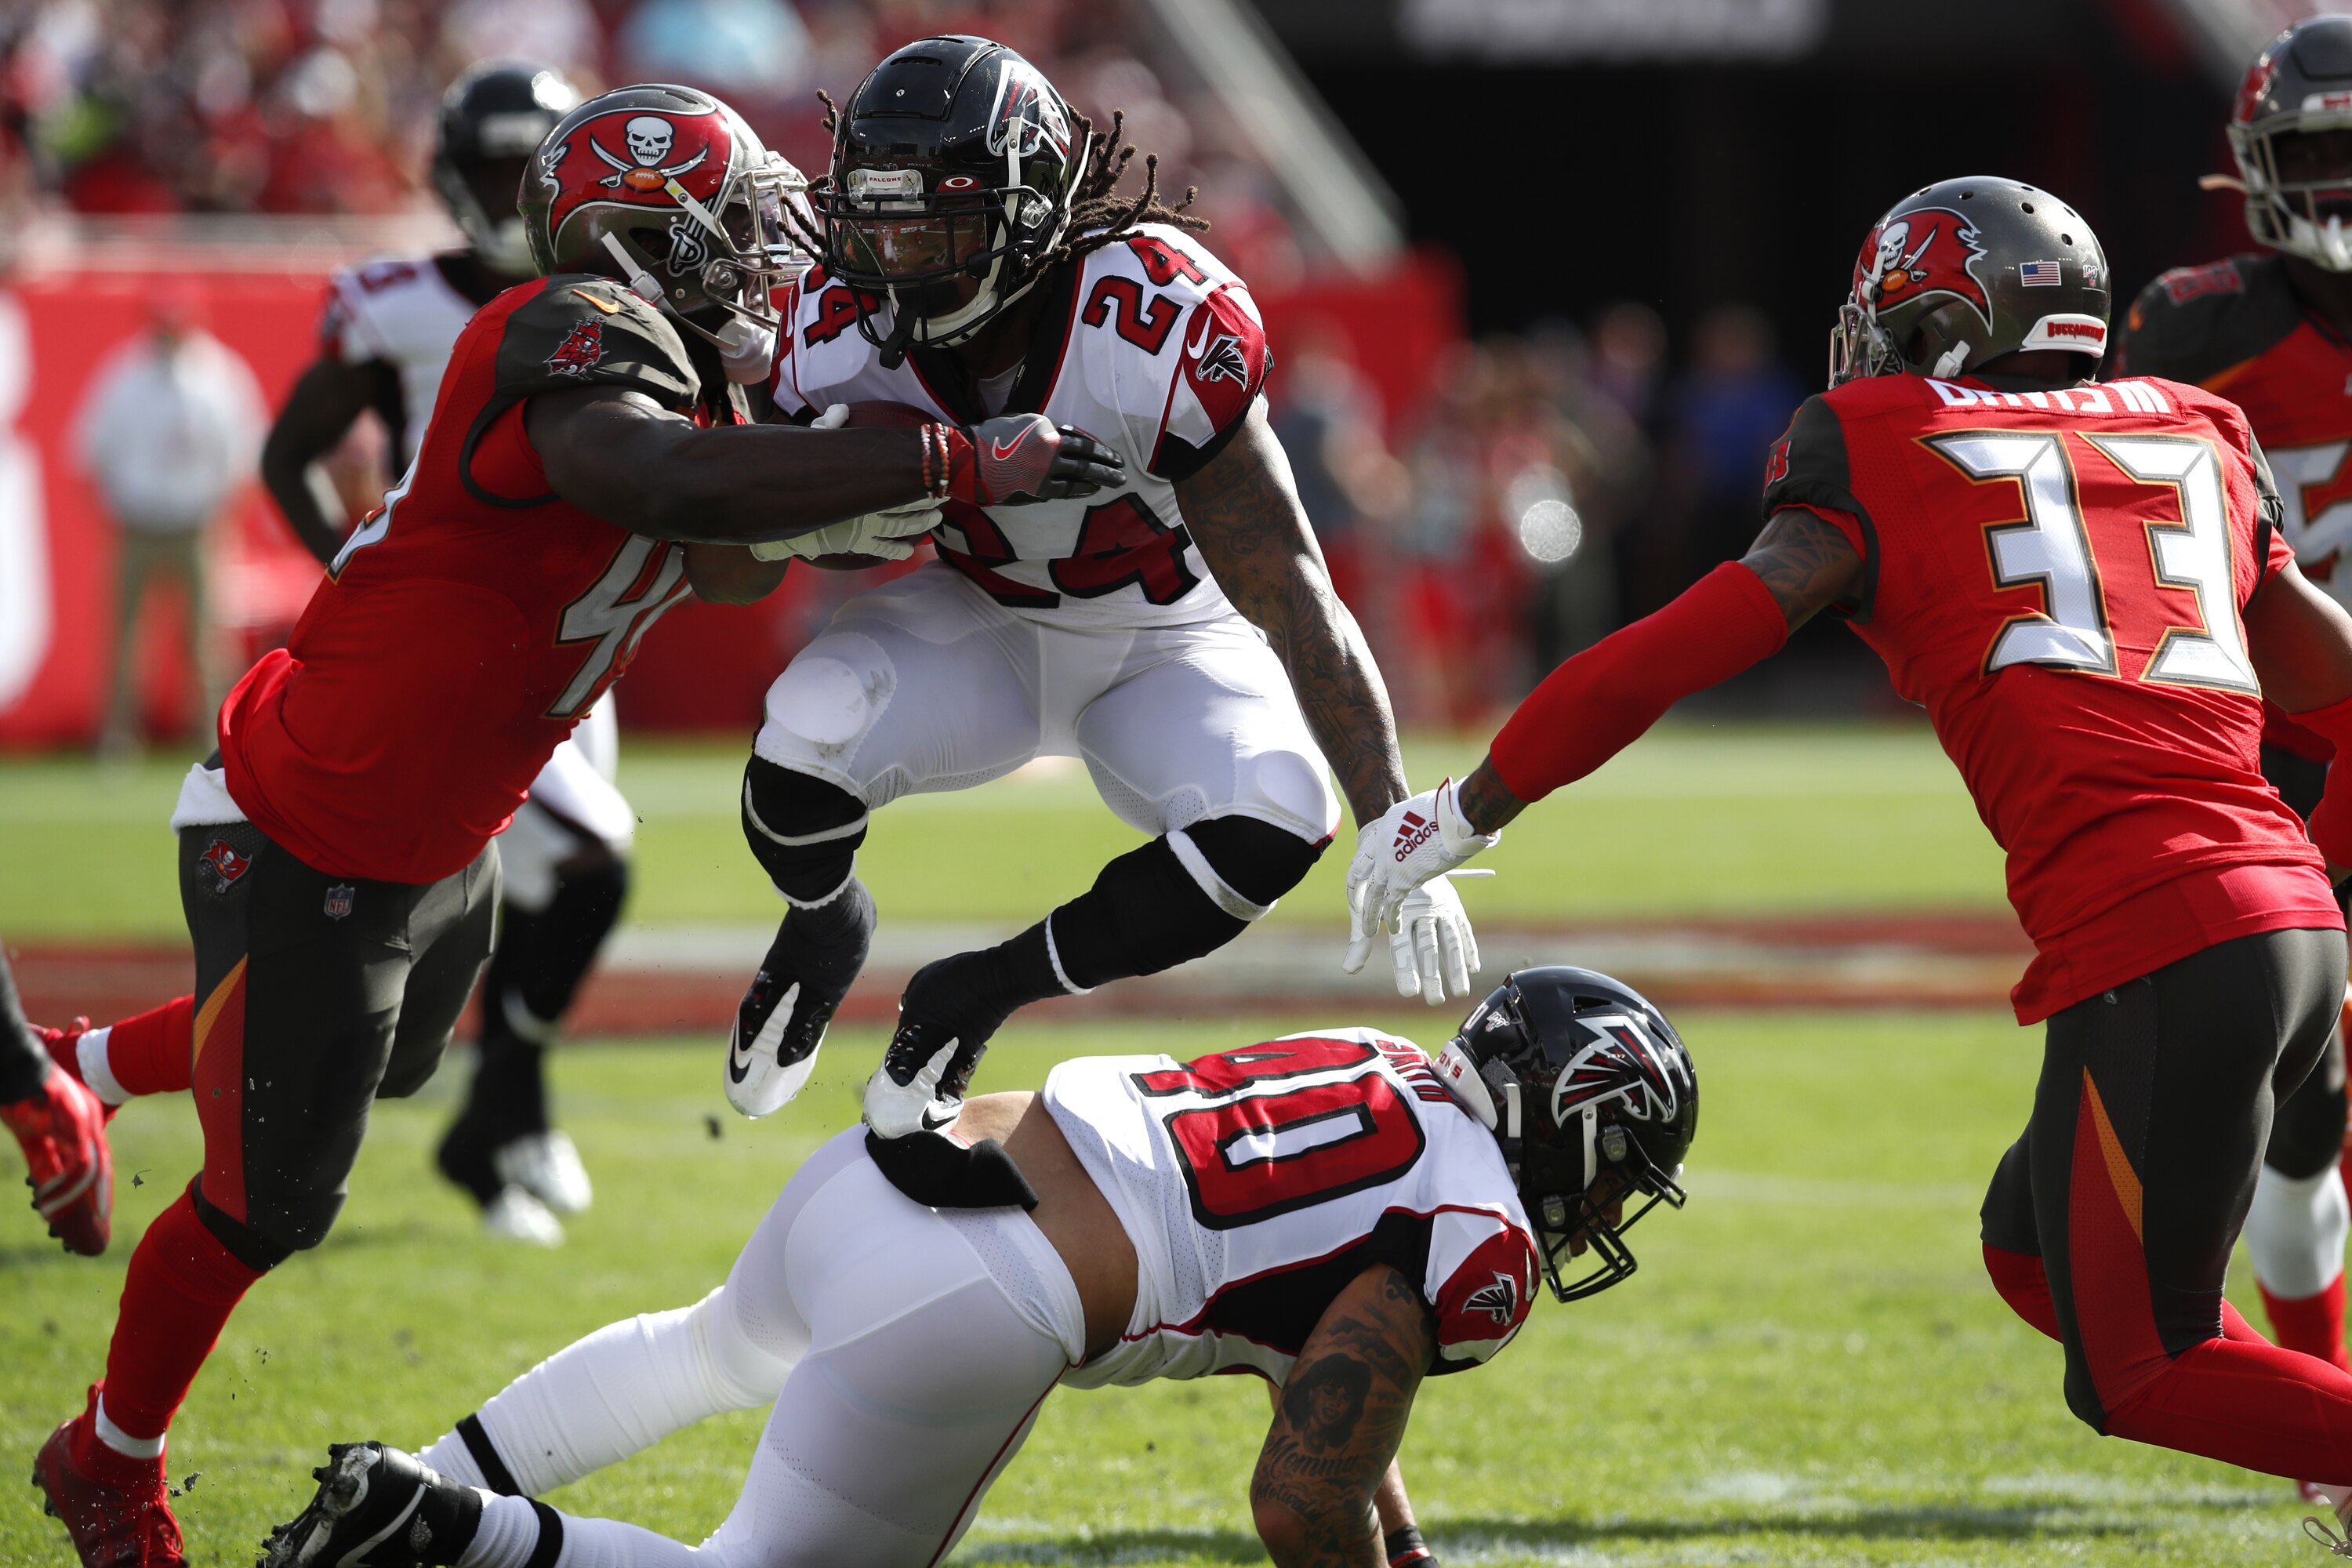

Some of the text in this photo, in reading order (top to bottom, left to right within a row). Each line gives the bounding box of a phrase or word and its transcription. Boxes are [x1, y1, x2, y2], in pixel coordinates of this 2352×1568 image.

[1081, 236, 1210, 357] 24
[931, 492, 1201, 606] 24
[1911, 428, 2263, 702] 33
[1394, 821, 1440, 862] adidas
[328, 898, 350, 914] NFL
[1129, 1036, 1426, 1231] 40
